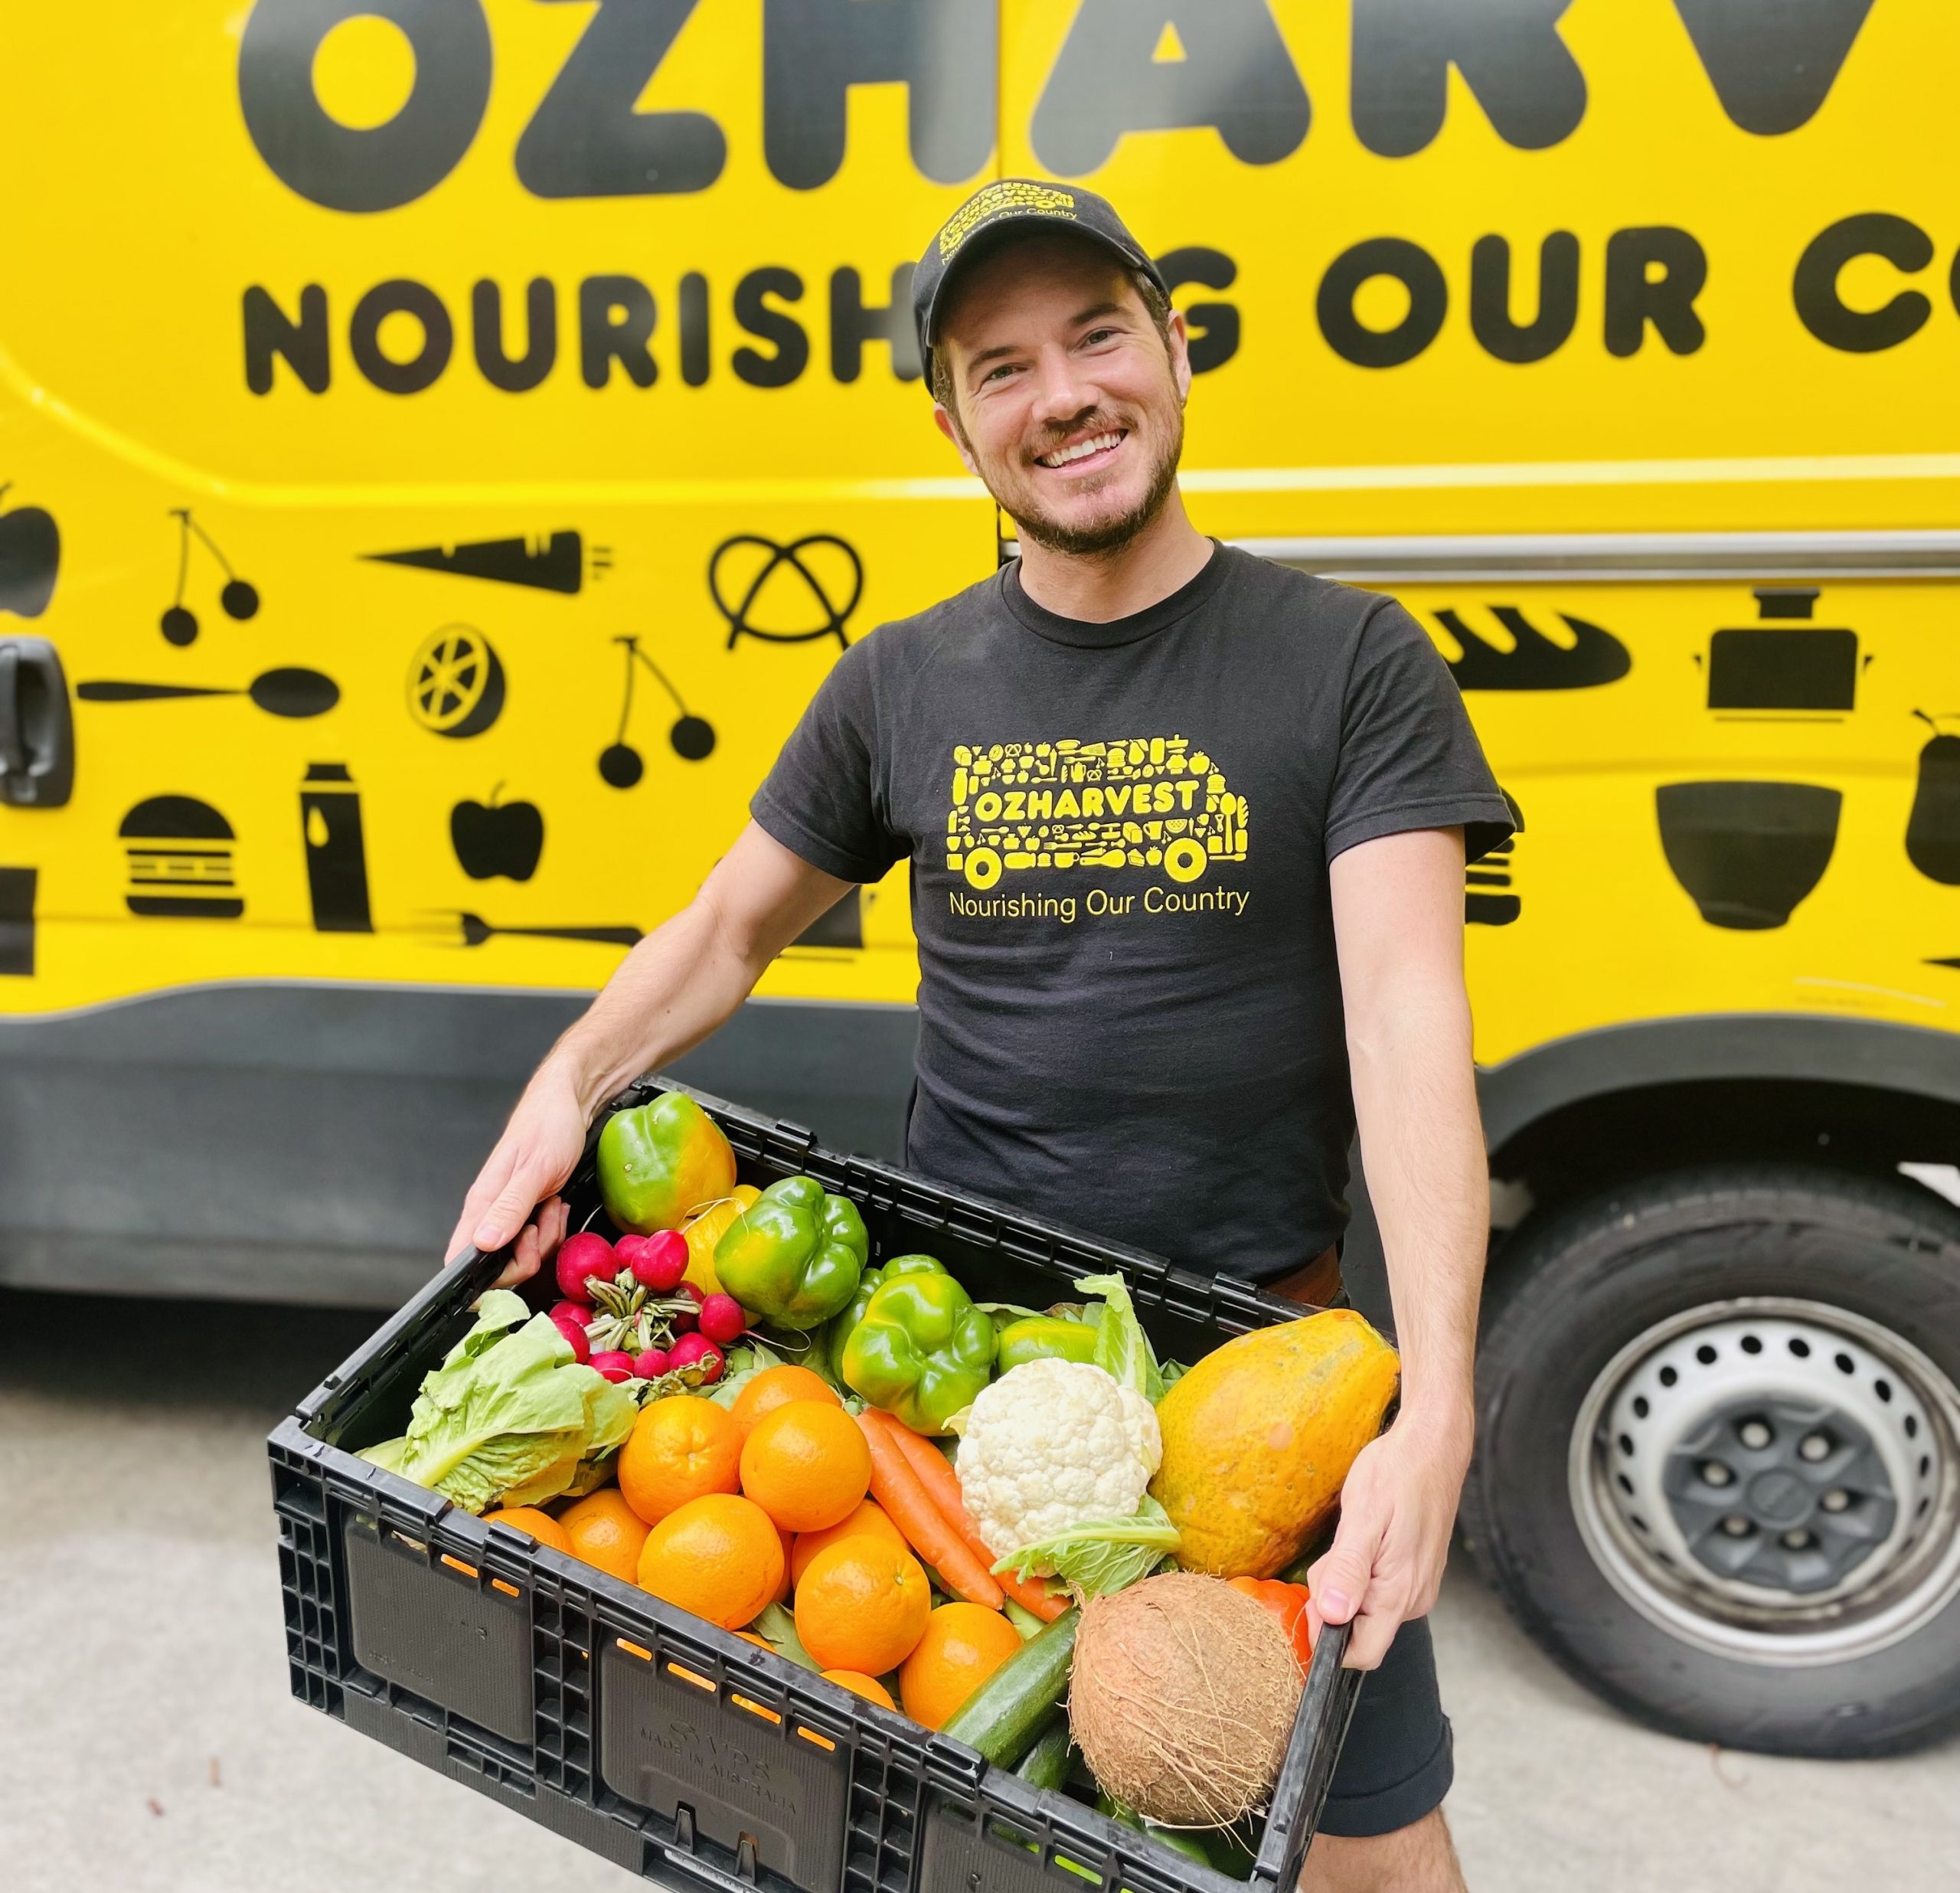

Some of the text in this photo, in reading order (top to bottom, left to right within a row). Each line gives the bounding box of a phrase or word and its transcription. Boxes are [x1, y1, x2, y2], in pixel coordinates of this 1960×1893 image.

[999, 210, 1023, 218] Our
[1026, 208, 1077, 221] Country
[243, 213, 1960, 395] NOURISHG OUR C
[975, 780, 1200, 822] OZHARVEST
[949, 885, 1250, 924] Nourishing Our Country
[640, 1726, 796, 1814] MADE IN AUSTRALIA
